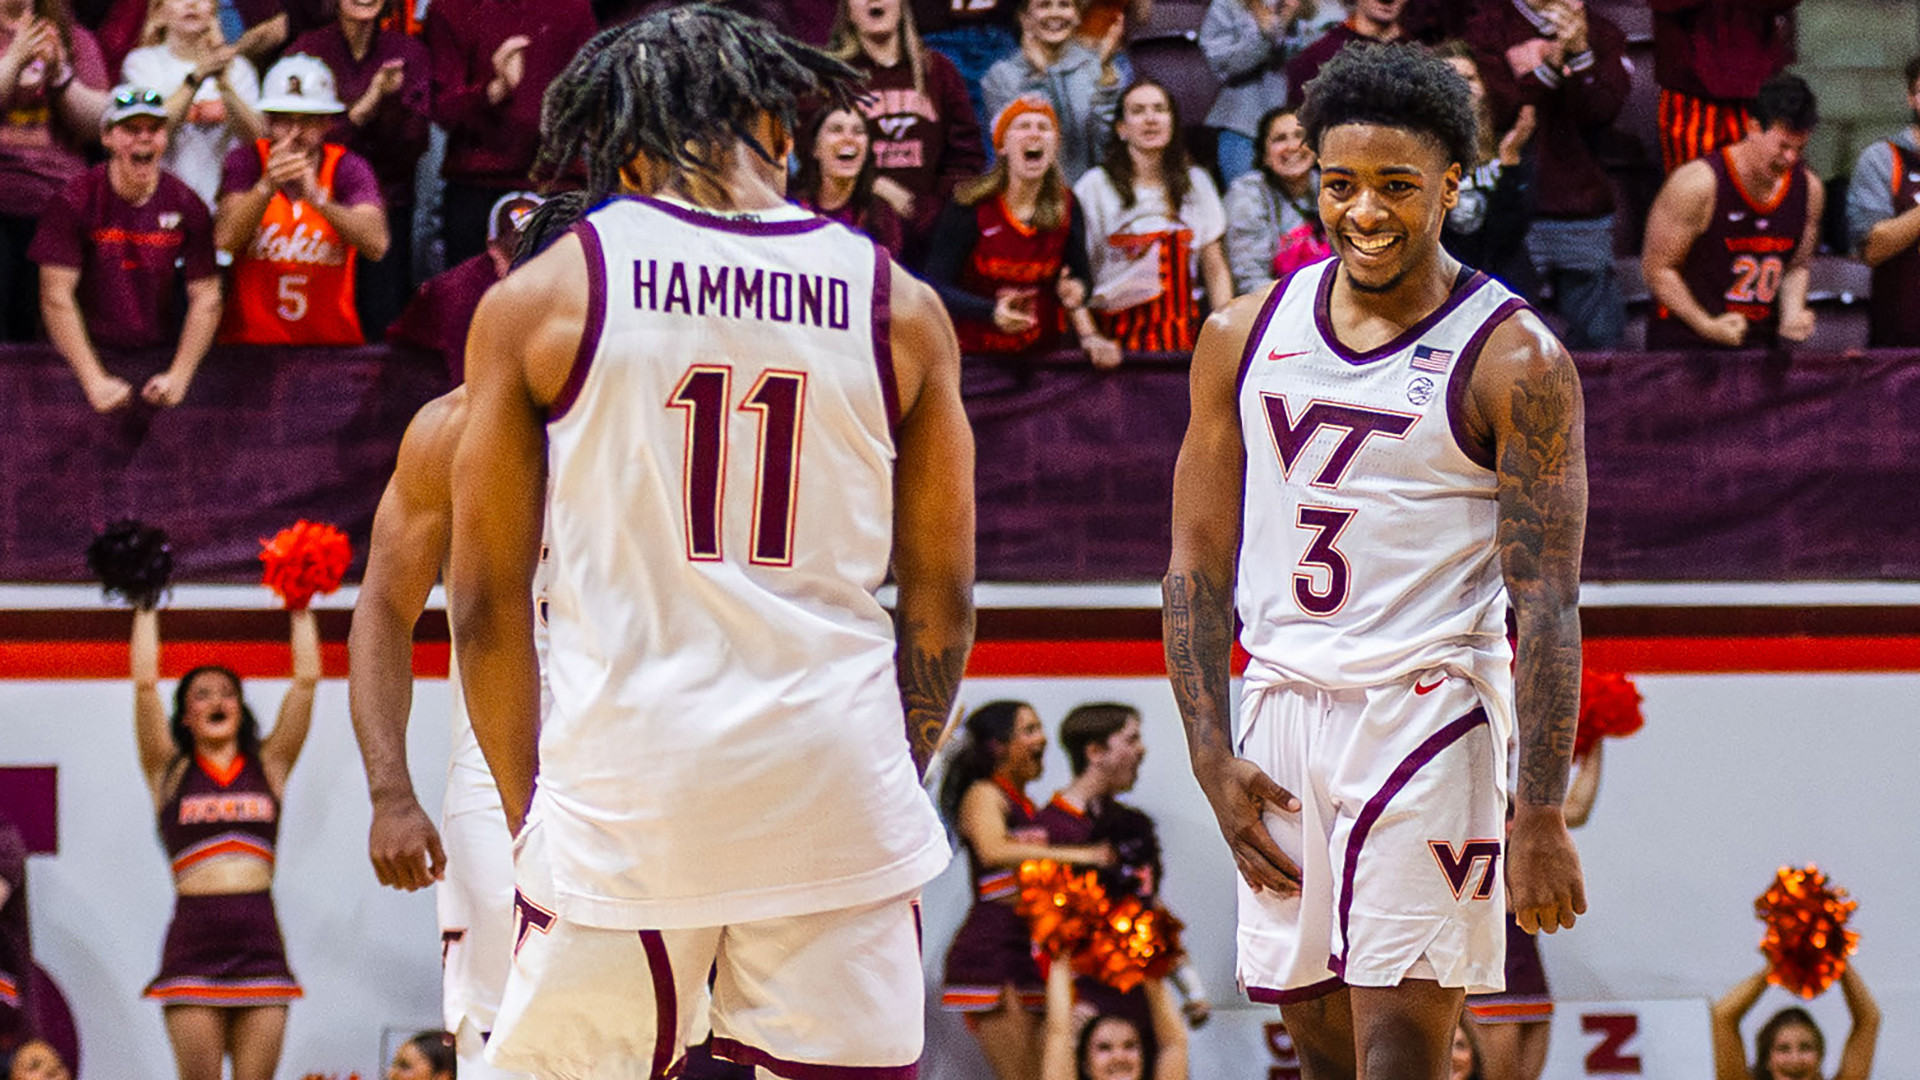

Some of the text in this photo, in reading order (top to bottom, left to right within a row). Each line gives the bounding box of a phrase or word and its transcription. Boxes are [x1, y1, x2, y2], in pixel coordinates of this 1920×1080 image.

[277, 274, 308, 321] 5
[633, 259, 849, 330] HAMMOND
[1724, 255, 1783, 303] 20
[665, 363, 808, 568] 11
[1259, 391, 1424, 489] VT
[1292, 504, 1359, 617] 3
[1427, 839, 1502, 901] VT
